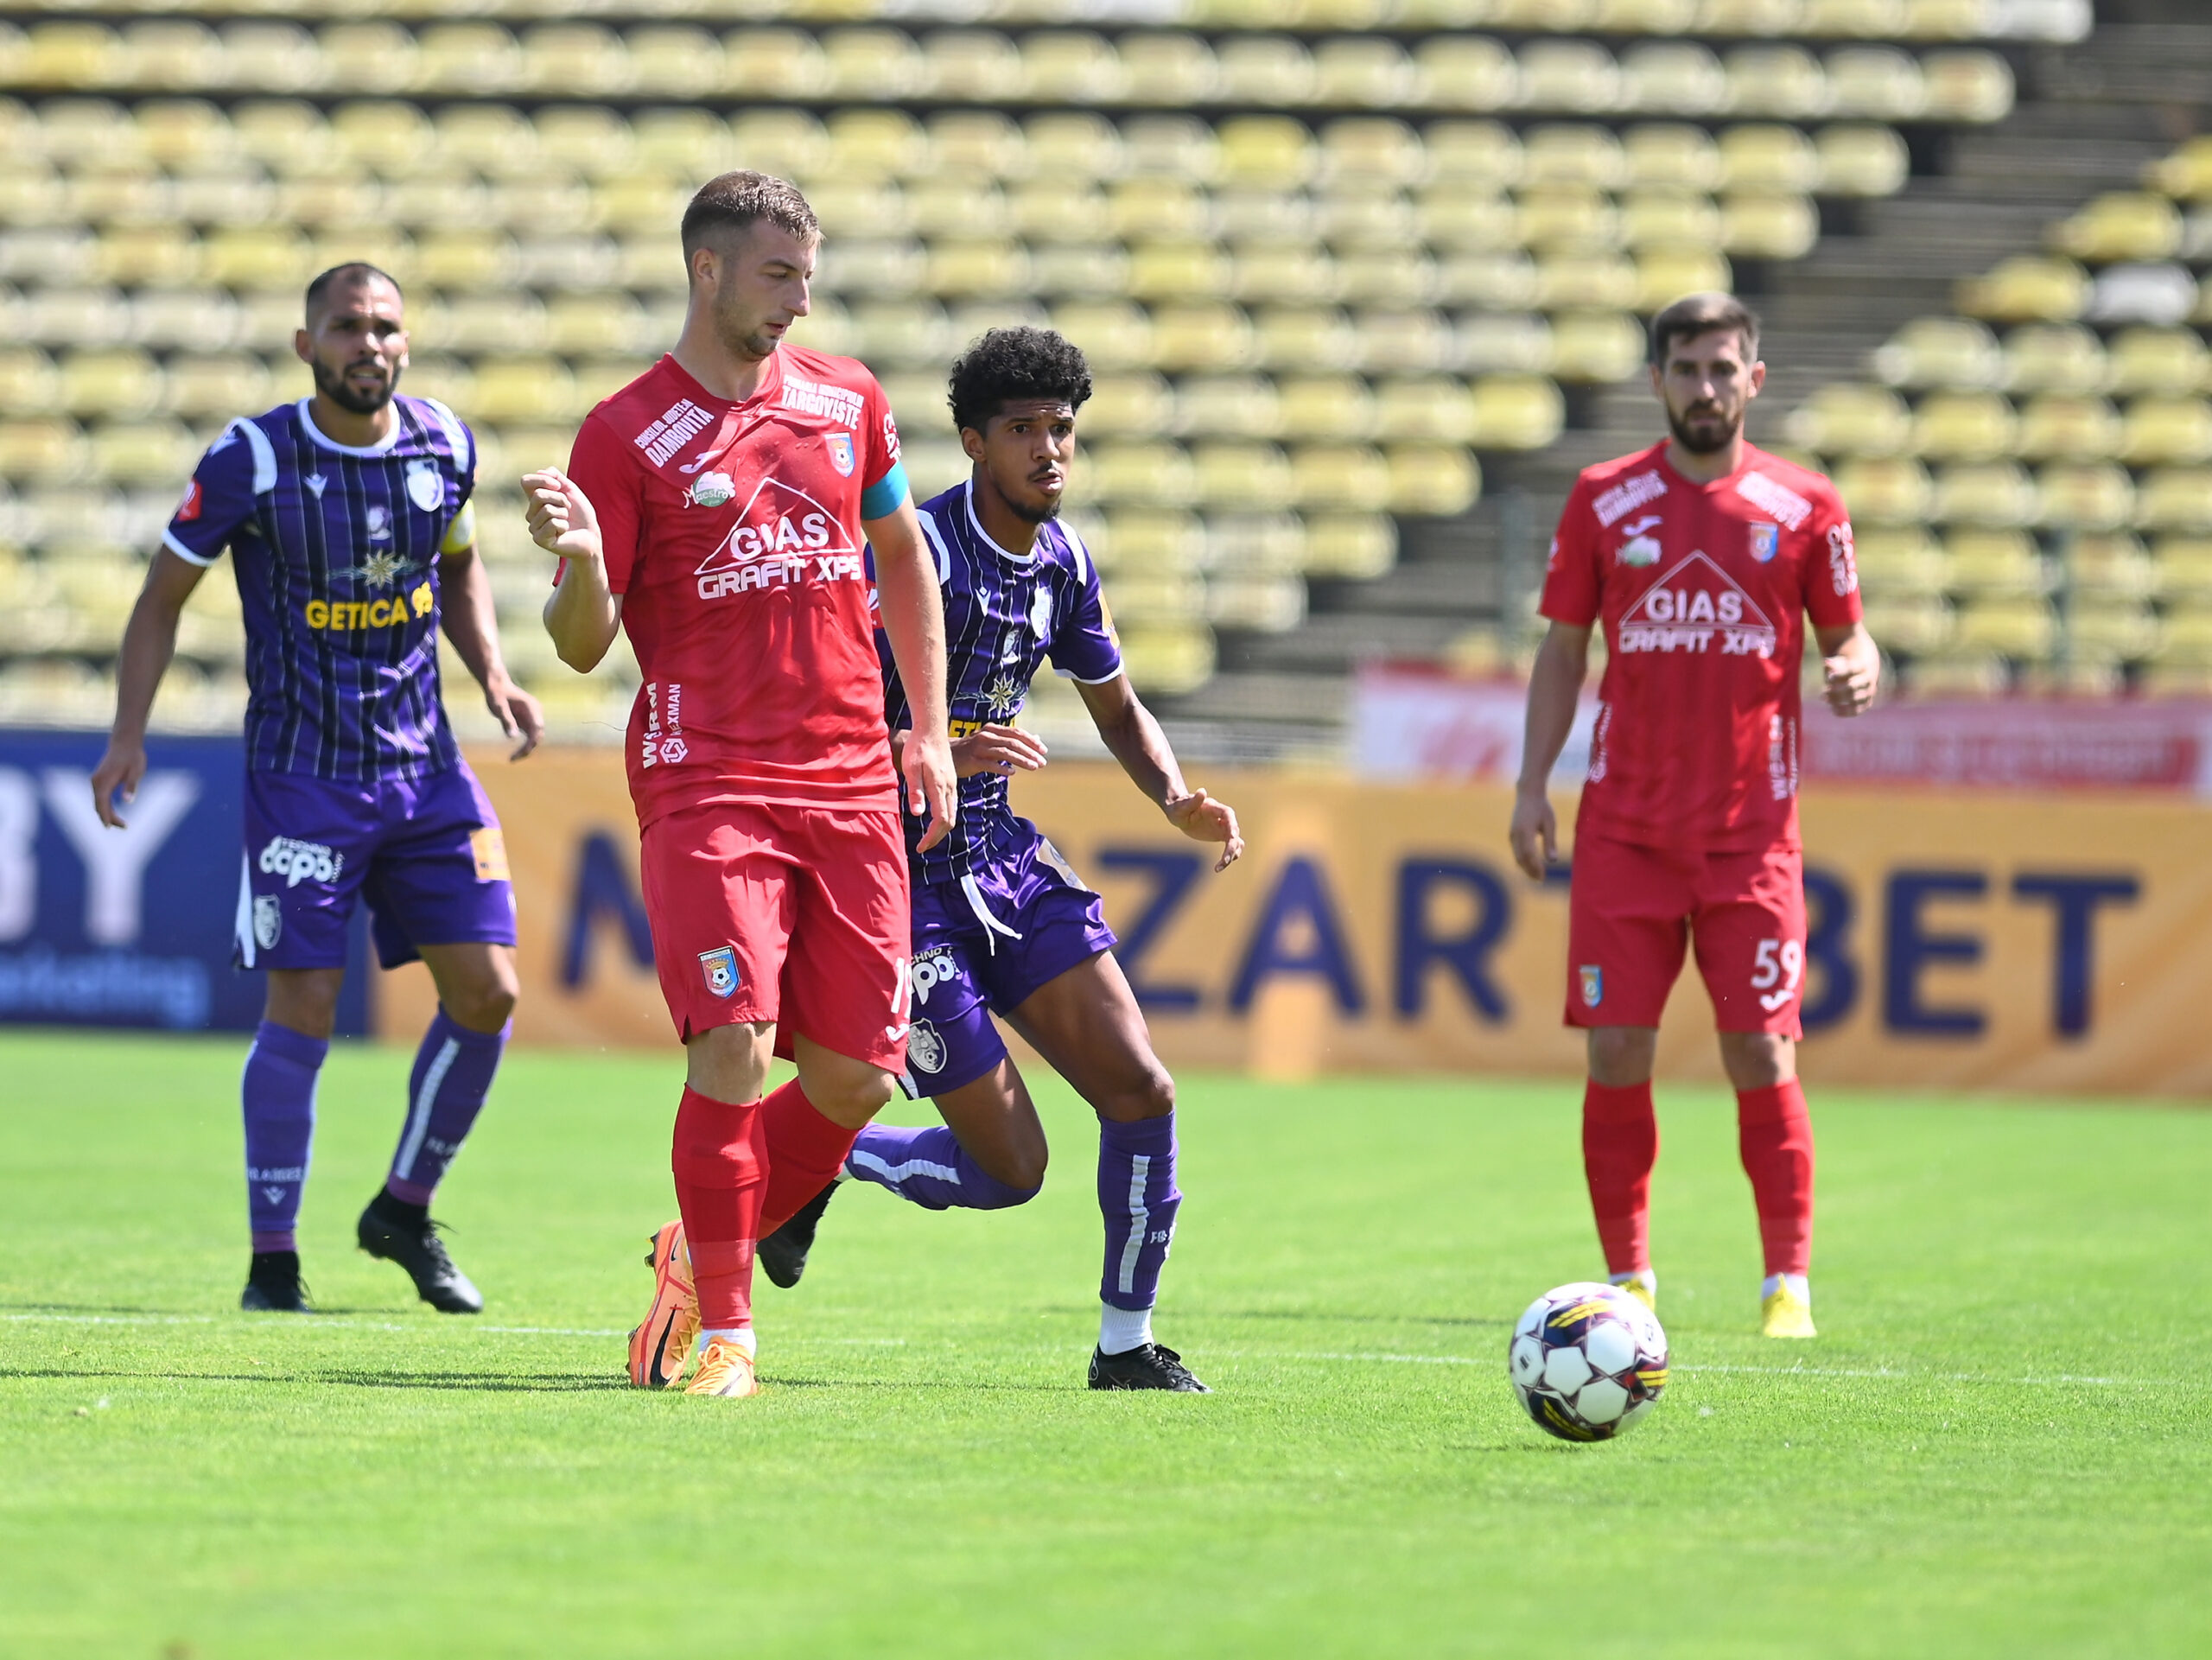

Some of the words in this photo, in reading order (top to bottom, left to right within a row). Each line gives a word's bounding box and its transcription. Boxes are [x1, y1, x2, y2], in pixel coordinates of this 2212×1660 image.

[645, 405, 715, 468] DAMBOVITA
[729, 512, 830, 561] GIAS
[697, 557, 805, 600] GRAFIT
[816, 555, 861, 582] XPS
[306, 595, 410, 631] GETICA
[1644, 588, 1743, 625] GIAS
[1751, 938, 1802, 989] 59
